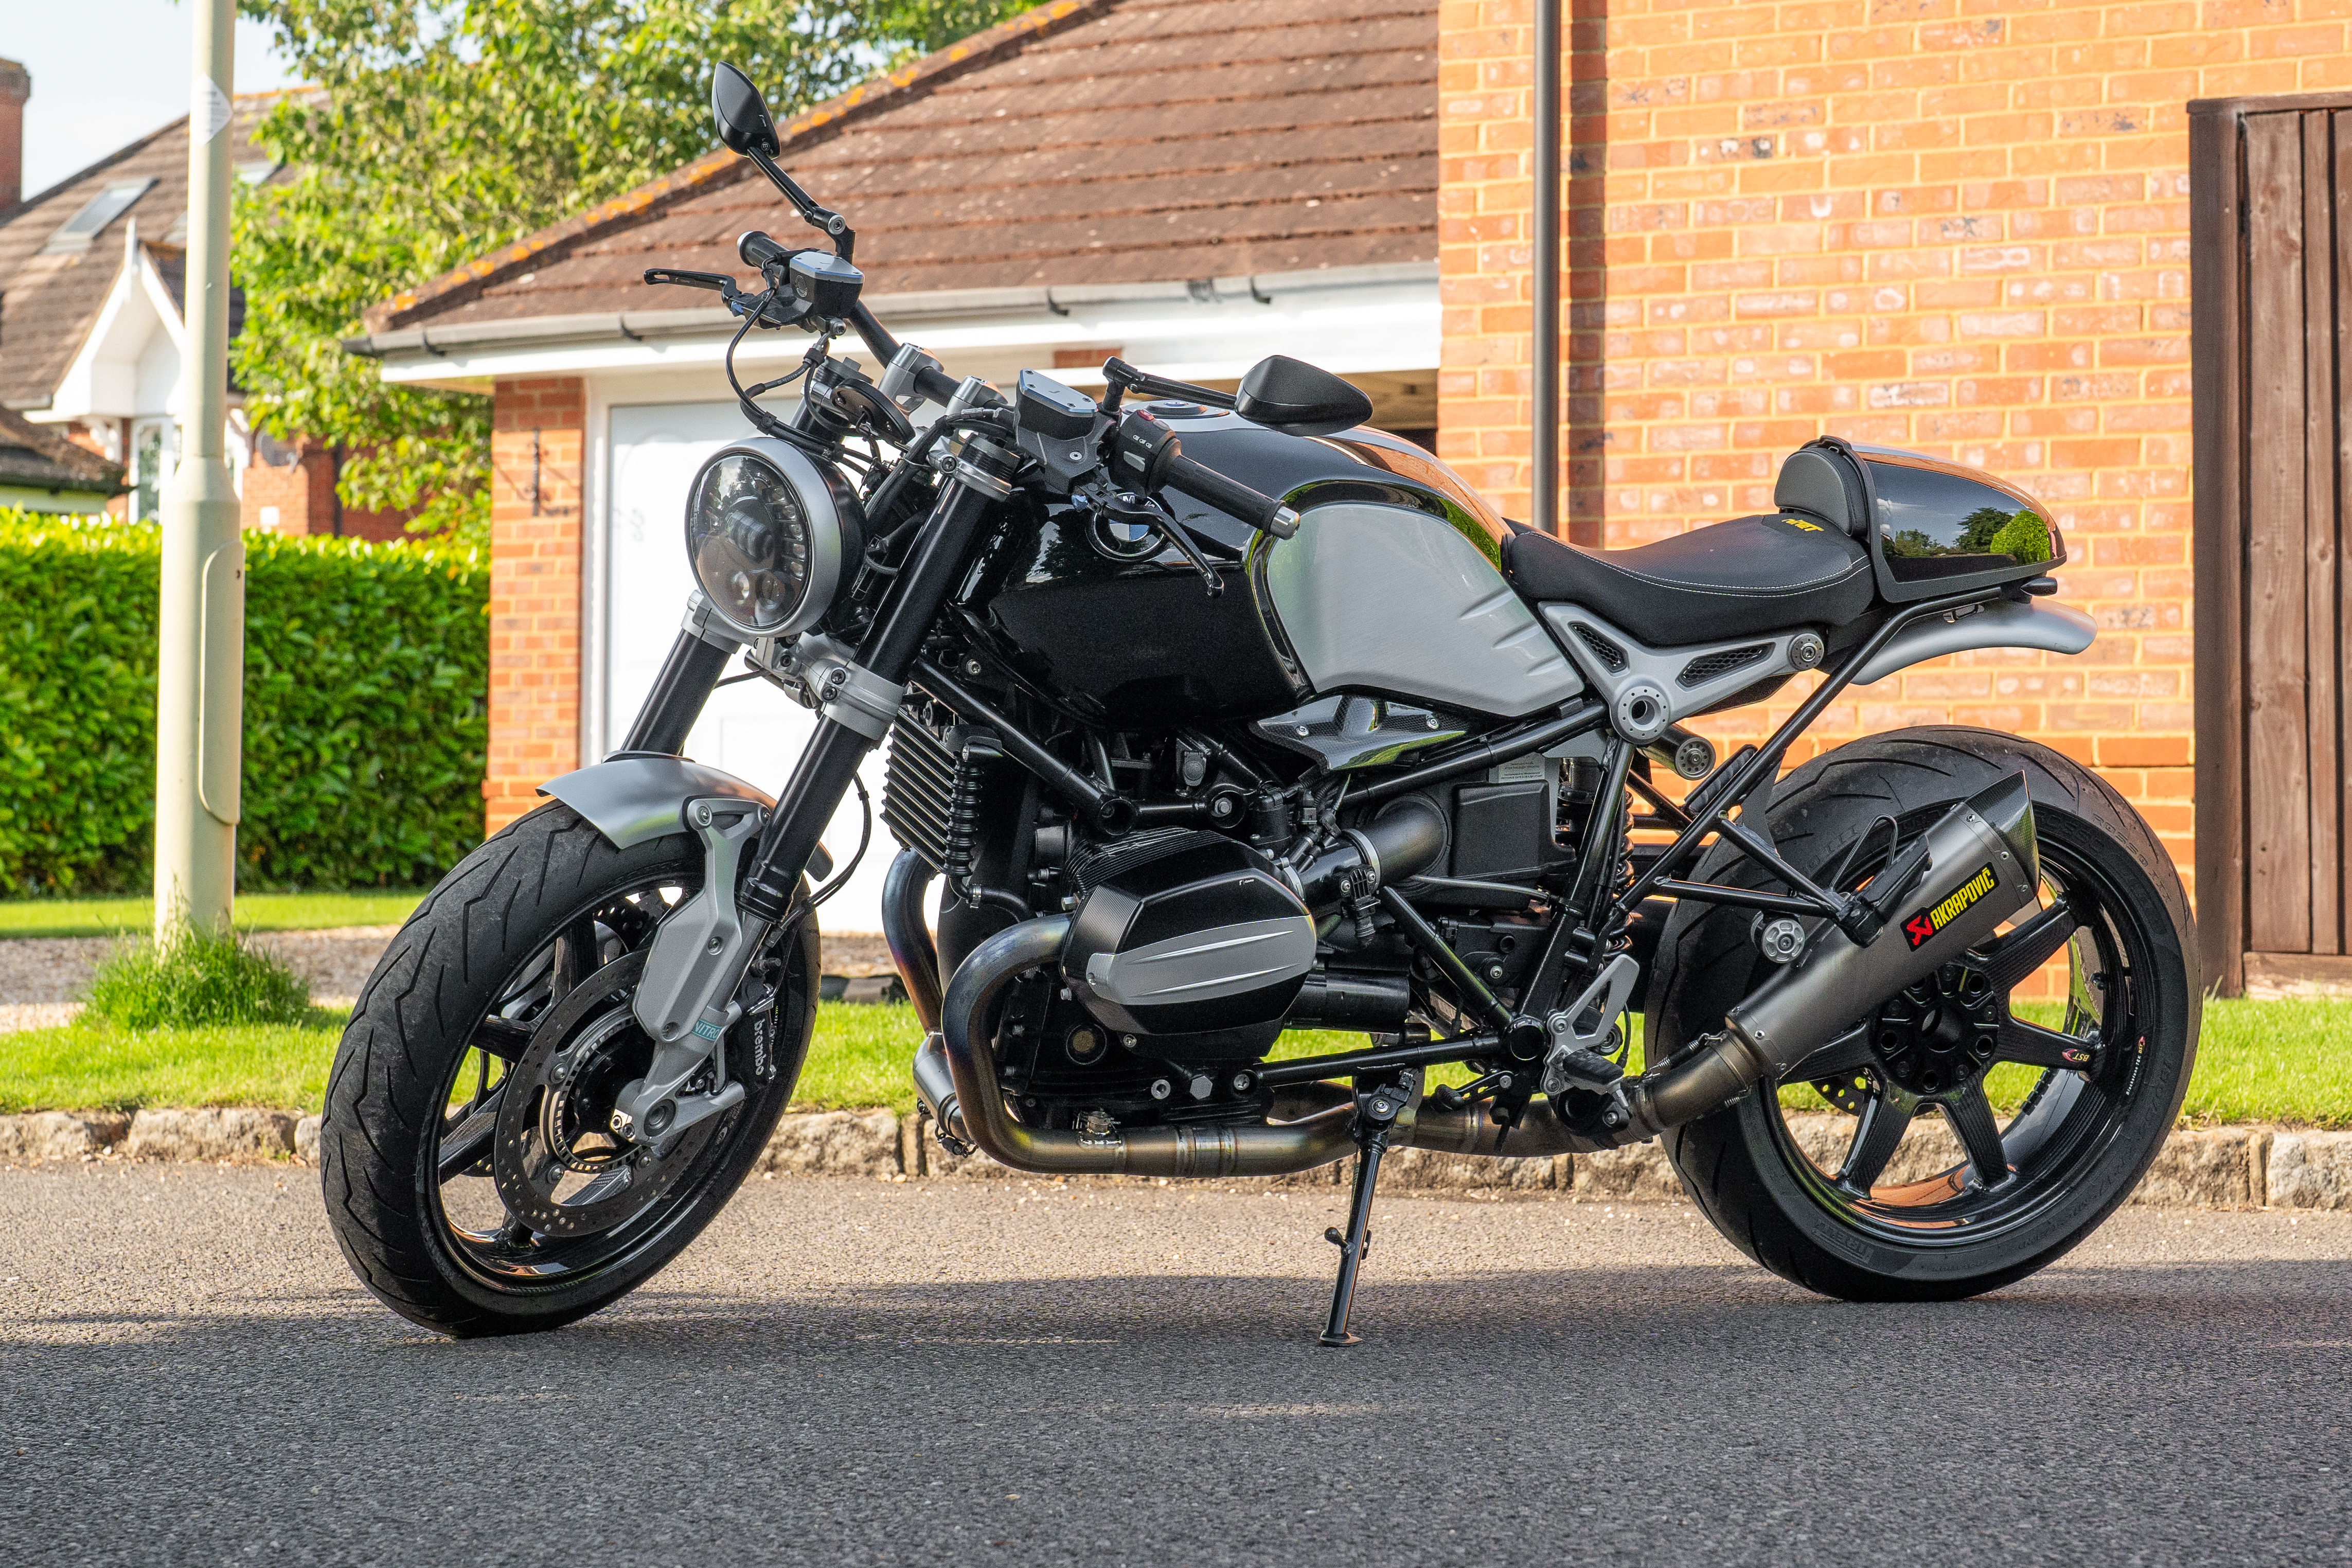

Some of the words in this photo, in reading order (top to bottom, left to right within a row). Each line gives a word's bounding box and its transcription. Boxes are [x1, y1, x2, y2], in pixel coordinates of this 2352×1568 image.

[2092, 813, 2149, 867] ROSSO
[754, 1018, 767, 1075] brembo
[2073, 1053, 2090, 1063] BST
